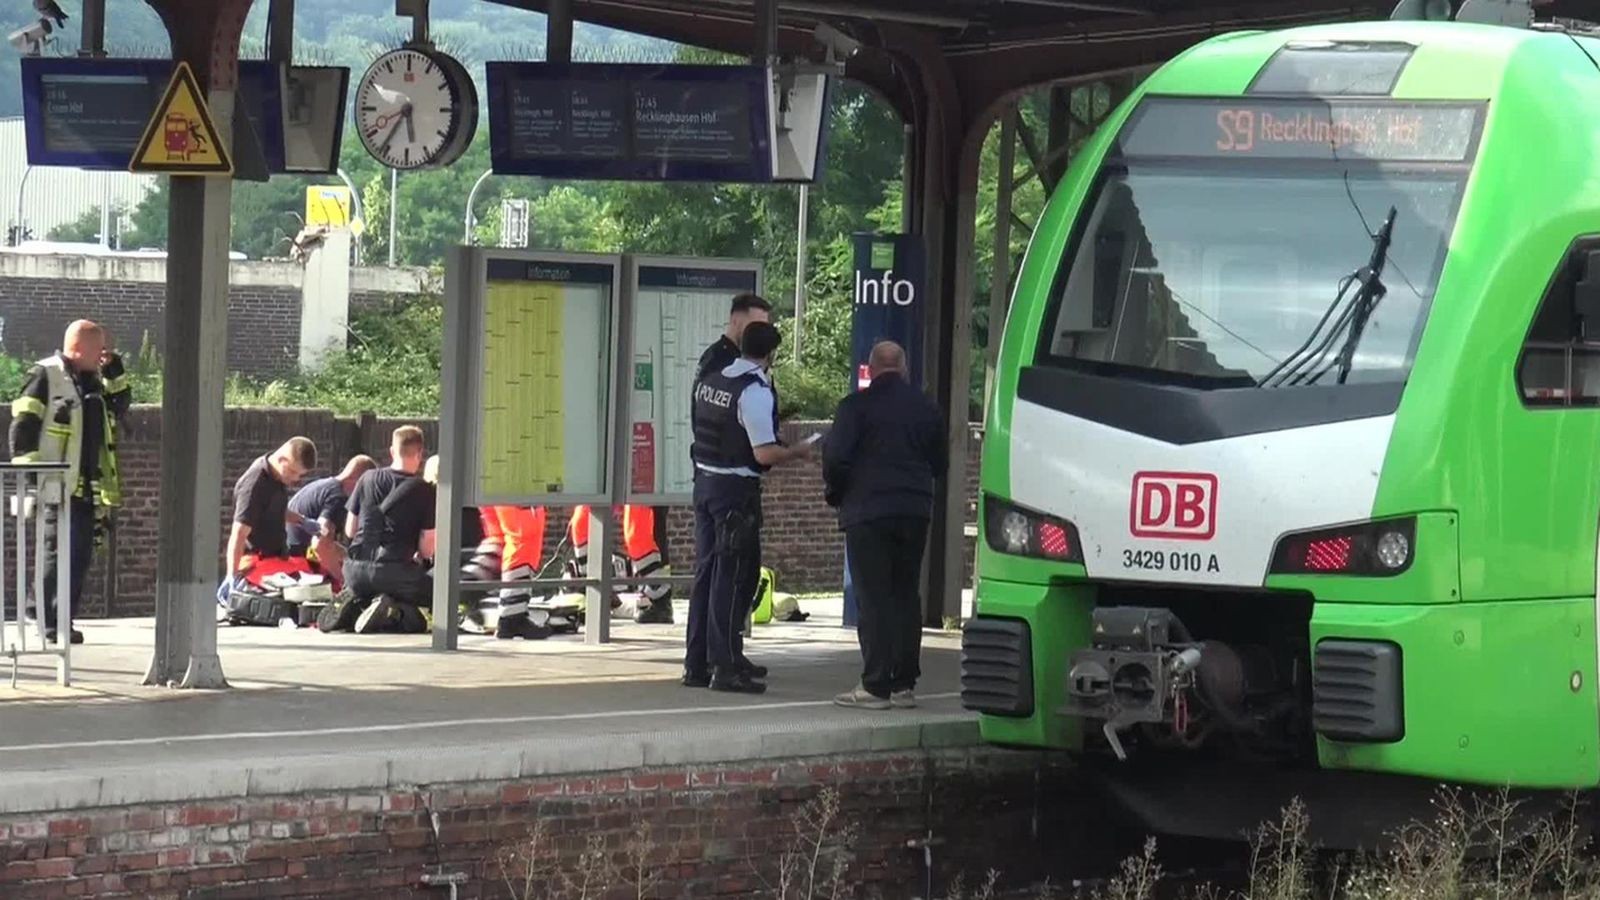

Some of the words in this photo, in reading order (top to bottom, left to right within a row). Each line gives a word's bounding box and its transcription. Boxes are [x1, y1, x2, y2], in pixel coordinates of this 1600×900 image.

[635, 109, 700, 124] Recklinghausen
[701, 111, 719, 124] Hbf
[1216, 109, 1254, 151] S9
[527, 263, 571, 280] Information
[675, 270, 720, 287] Information
[855, 269, 915, 306] Info
[699, 383, 733, 408] POLIZEI
[1140, 481, 1206, 529] DB
[1122, 548, 1165, 571] 3429
[1169, 551, 1202, 573] 010
[1206, 553, 1220, 573] A
